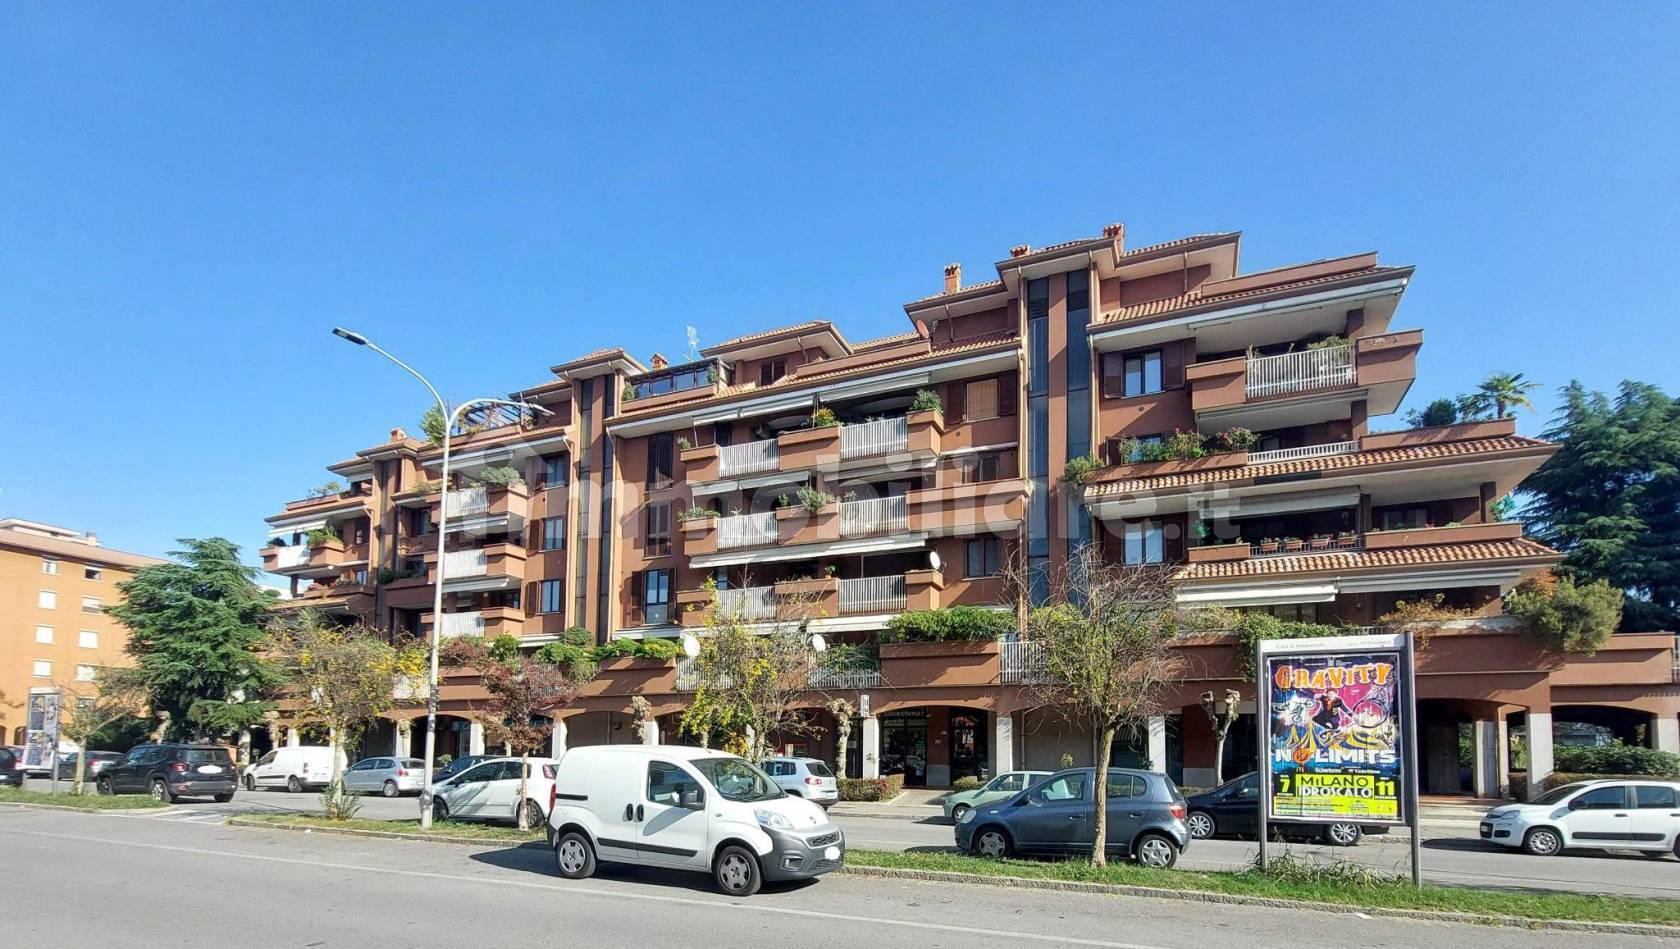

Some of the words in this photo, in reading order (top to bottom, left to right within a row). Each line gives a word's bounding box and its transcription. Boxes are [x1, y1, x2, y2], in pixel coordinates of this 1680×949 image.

[1275, 661, 1393, 690] GRAVITY
[1314, 748, 1396, 764] LIMITS
[1280, 779, 1290, 792] 7
[1298, 786, 1372, 798] IDROSCALO
[1375, 781, 1395, 795] 11
